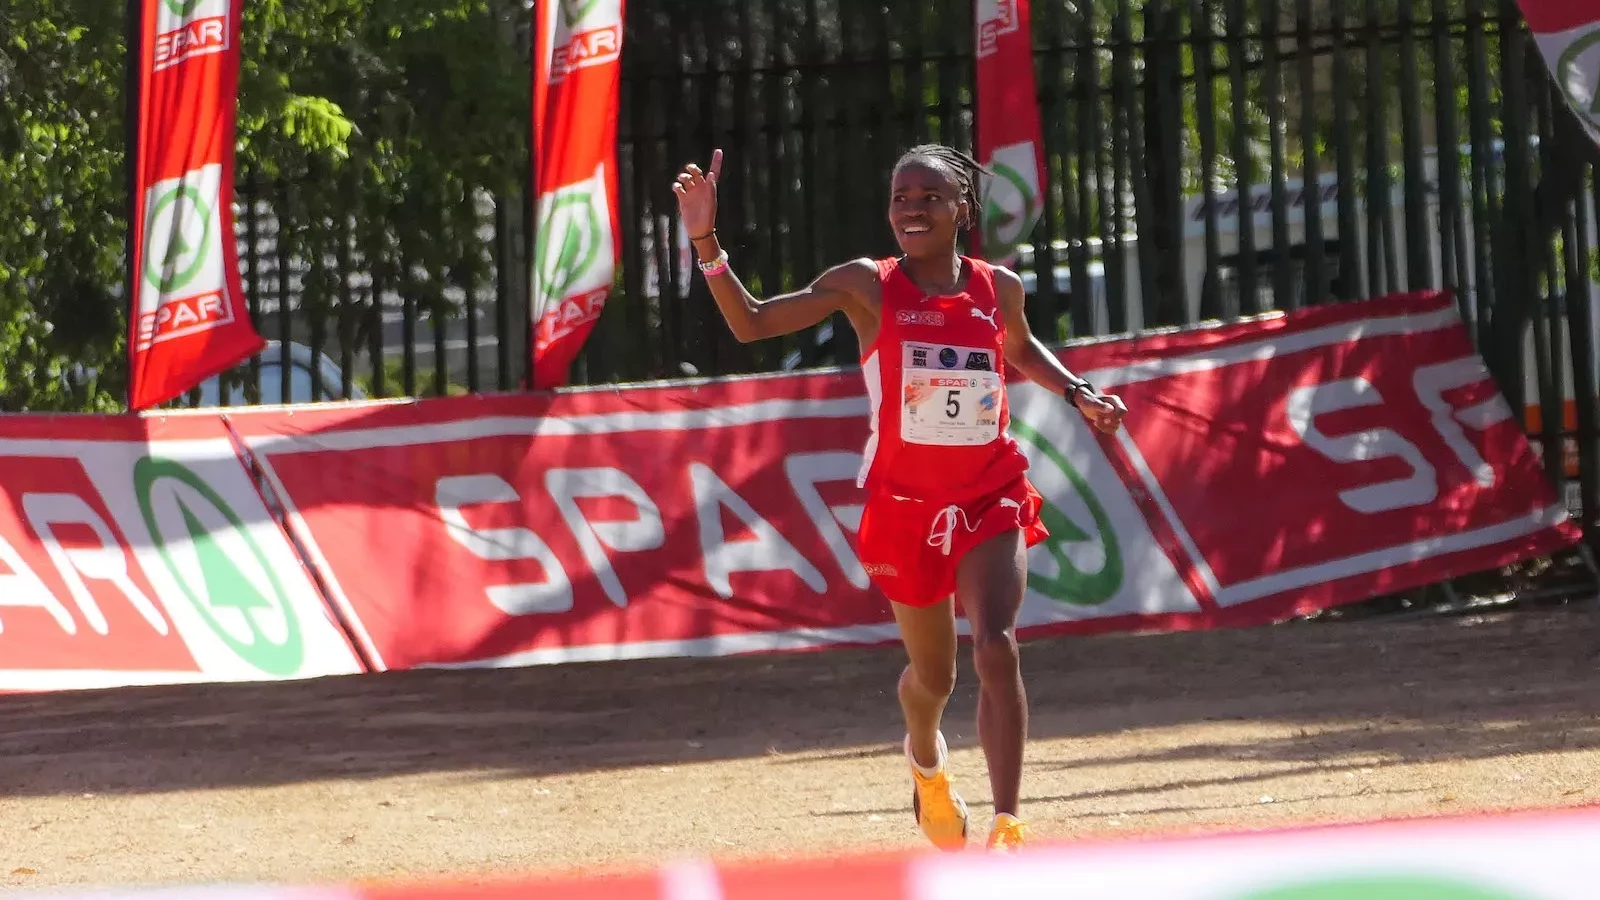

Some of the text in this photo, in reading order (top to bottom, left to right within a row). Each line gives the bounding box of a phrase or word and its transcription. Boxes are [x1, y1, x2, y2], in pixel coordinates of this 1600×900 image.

[154, 19, 223, 62] SPAR
[969, 354, 988, 364] ASA
[945, 390, 961, 419] 5
